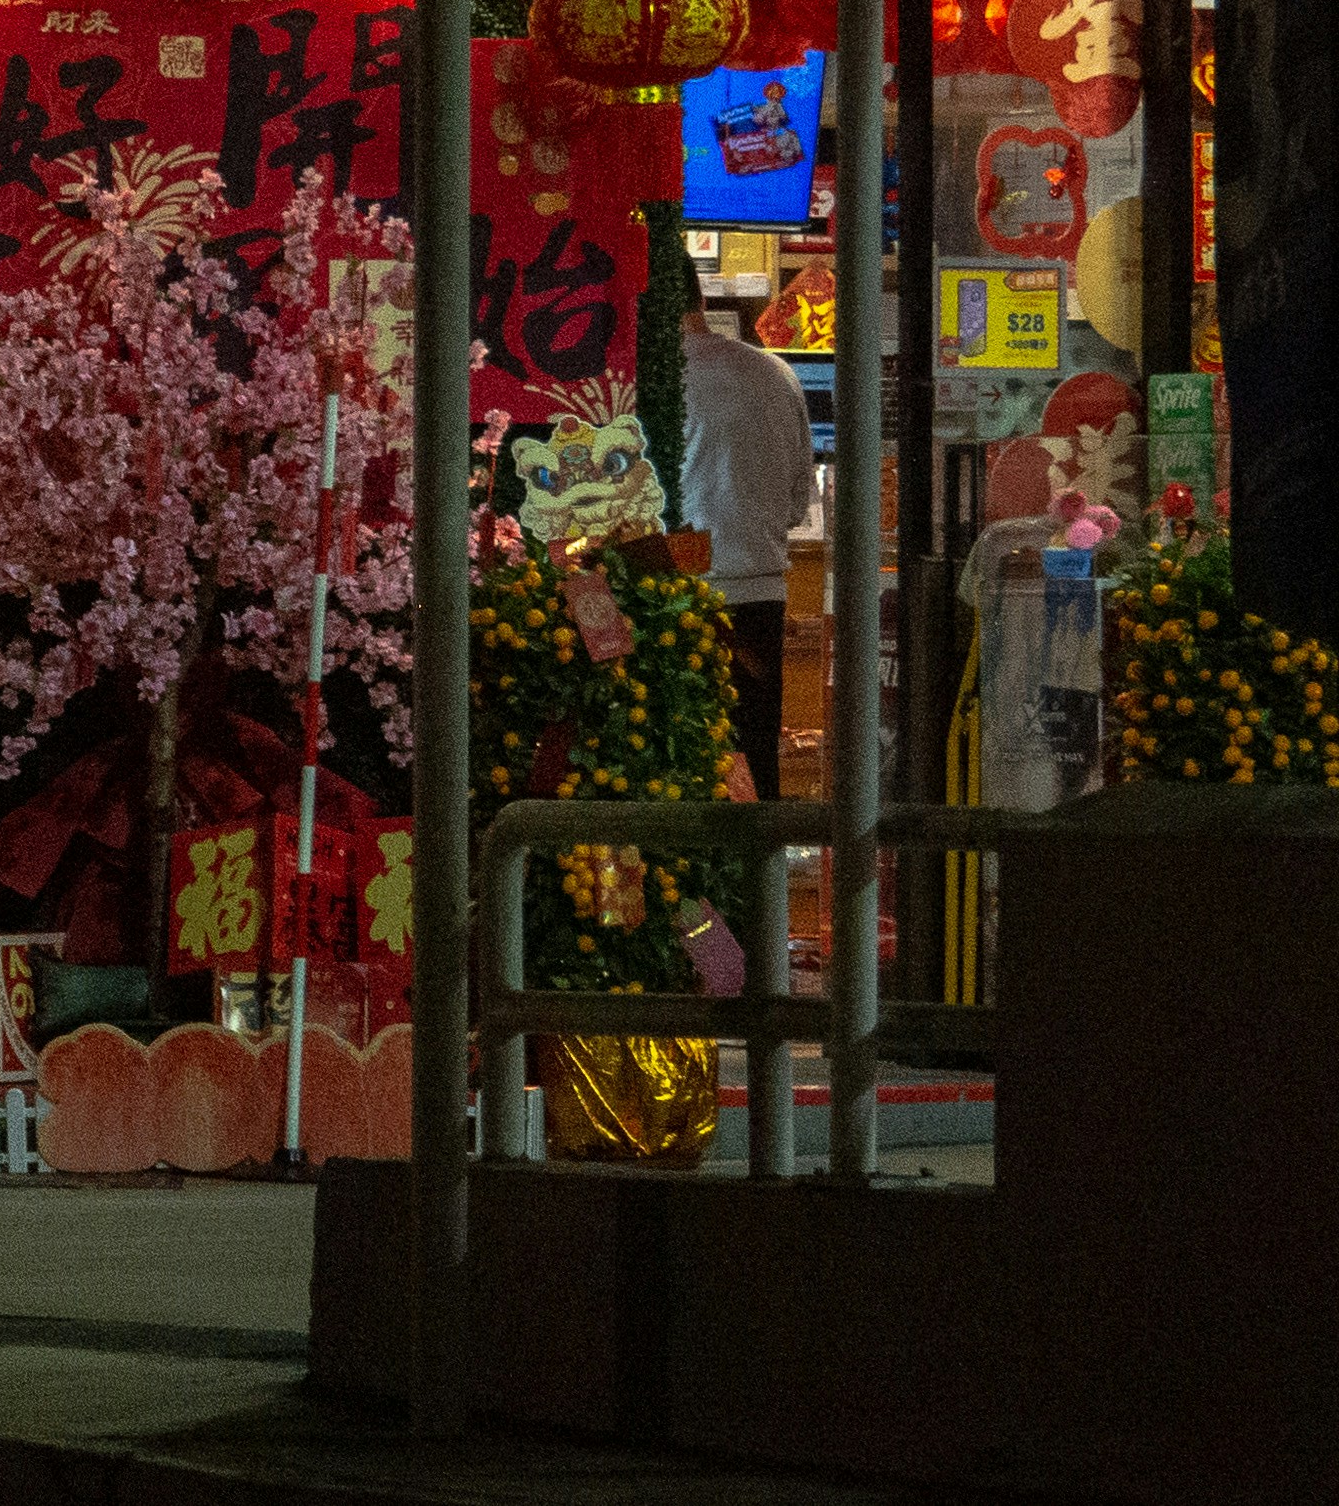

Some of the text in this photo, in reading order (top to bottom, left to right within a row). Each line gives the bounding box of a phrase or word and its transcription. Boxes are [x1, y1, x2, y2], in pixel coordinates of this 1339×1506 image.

[1007, 312, 1045, 333] $28
[1154, 380, 1202, 415] Sprite
[174, 827, 265, 960] 福
